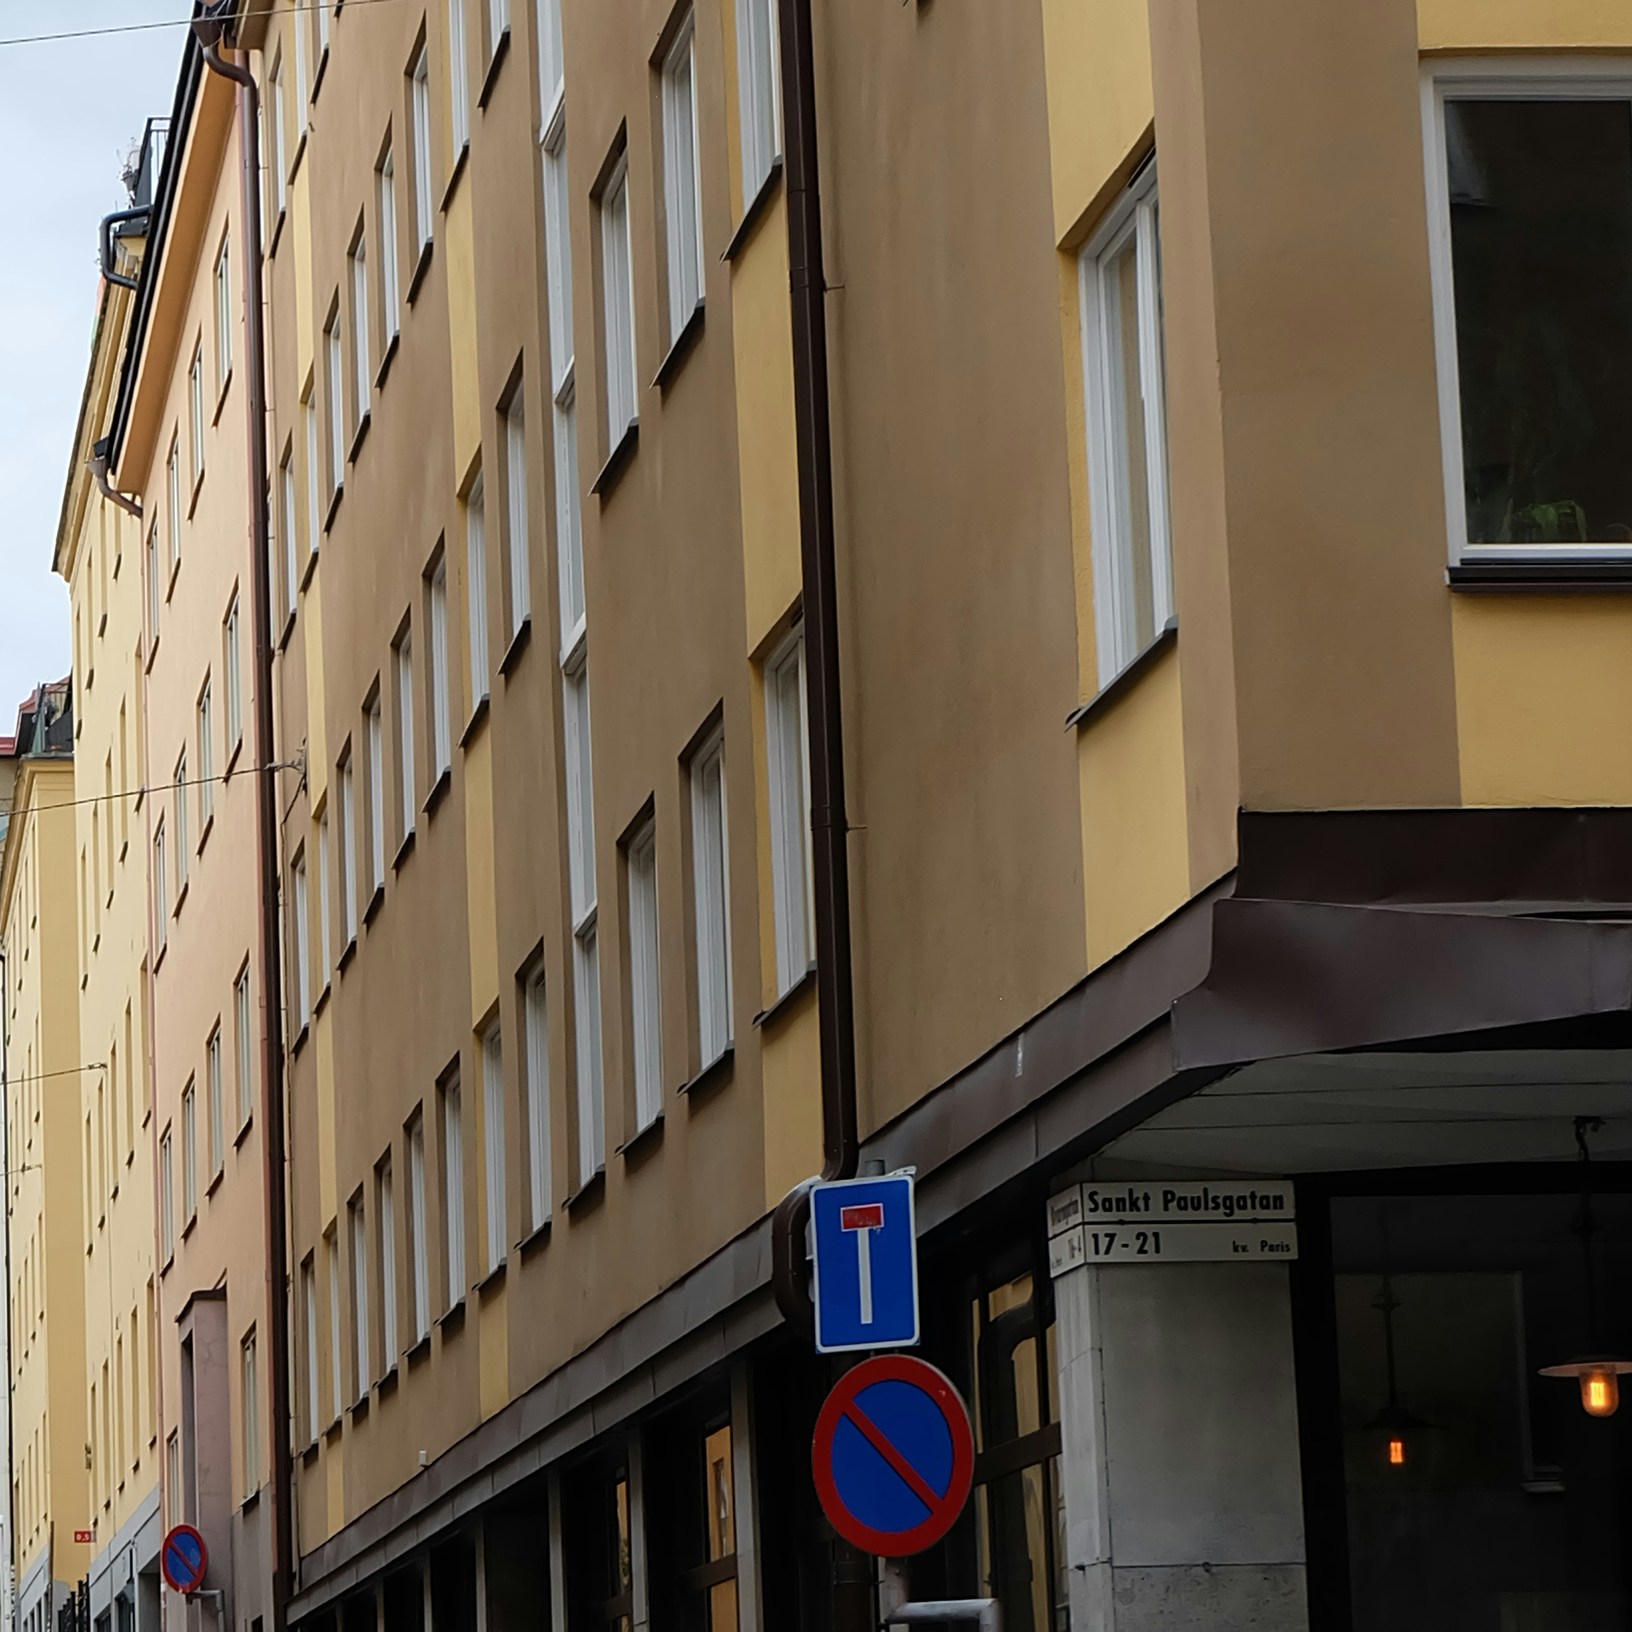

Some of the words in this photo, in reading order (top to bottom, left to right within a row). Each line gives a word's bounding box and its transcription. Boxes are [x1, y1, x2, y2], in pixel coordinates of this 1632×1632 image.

[1087, 1187, 1152, 1213] Sankt
[1161, 1186, 1285, 1218] Paulsgatan
[1091, 1231, 1161, 1256] 17-21
[1231, 1239, 1250, 1254] kv.
[1259, 1239, 1292, 1253] Paris
